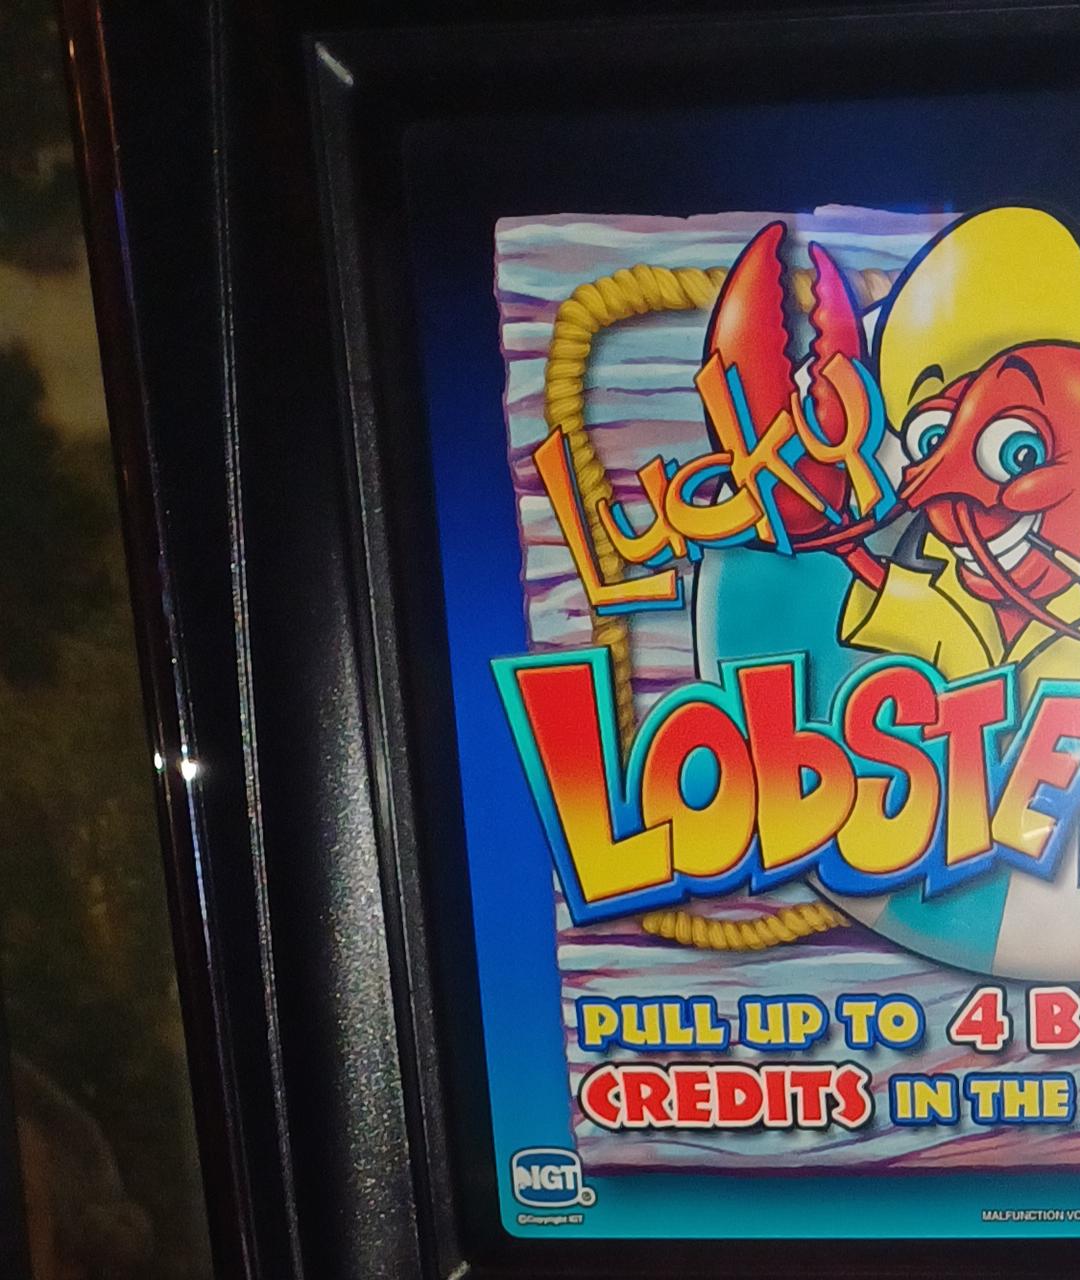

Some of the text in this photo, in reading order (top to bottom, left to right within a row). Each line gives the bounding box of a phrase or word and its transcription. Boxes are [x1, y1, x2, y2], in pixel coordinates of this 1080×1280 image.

[534, 350, 900, 615] Lucky
[577, 996, 730, 1050] PULL
[738, 996, 830, 1049] UP
[836, 995, 925, 1049] TO
[947, 986, 1013, 1052] 4
[578, 1062, 872, 1130] CREDITS
[888, 1073, 961, 1126] IN
[964, 1071, 1075, 1124] THE
[982, 1210, 1064, 1222] MALFUNCTION
